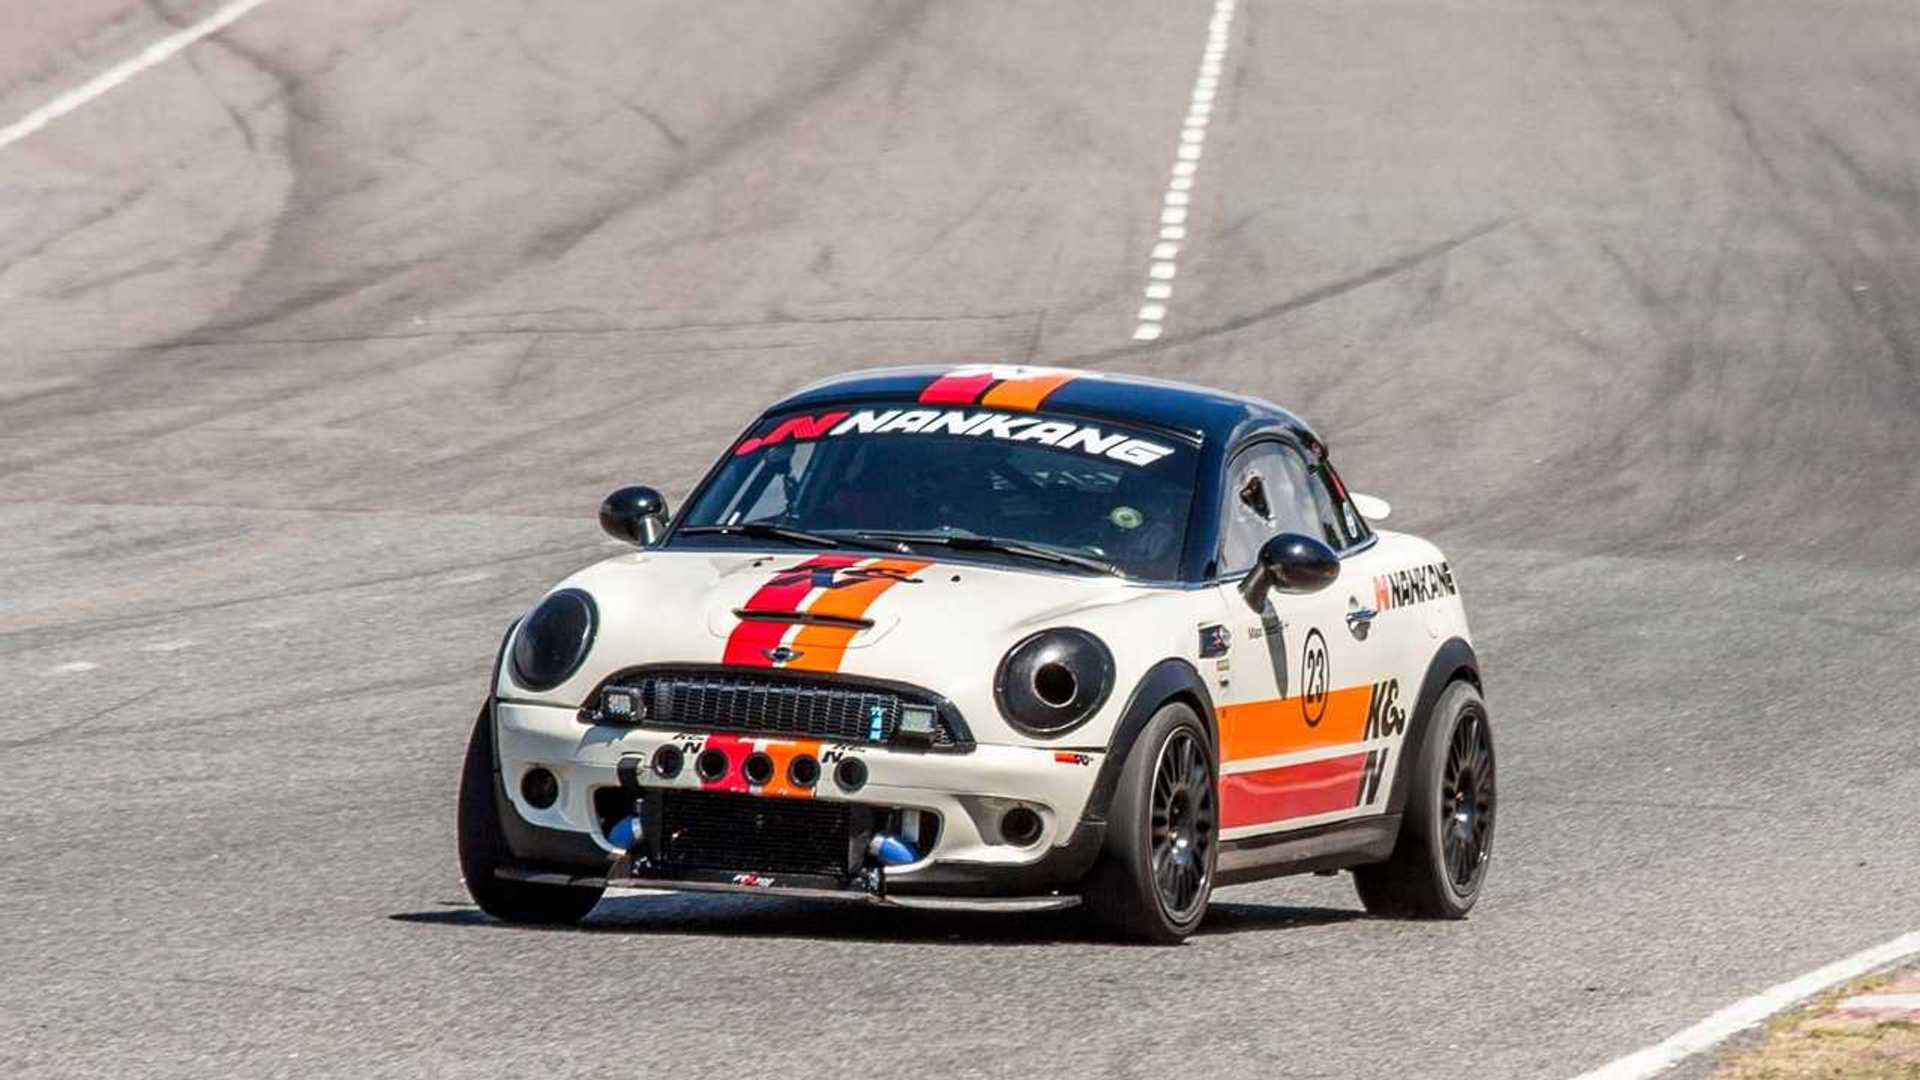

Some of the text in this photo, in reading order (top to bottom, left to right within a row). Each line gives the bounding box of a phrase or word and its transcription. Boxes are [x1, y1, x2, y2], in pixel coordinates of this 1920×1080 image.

[830, 410, 1175, 467] NANKANG
[1388, 561, 1456, 609] NANKANG
[1306, 649, 1324, 704] 23
[1364, 678, 1405, 741] K&
[1356, 748, 1390, 807] N
